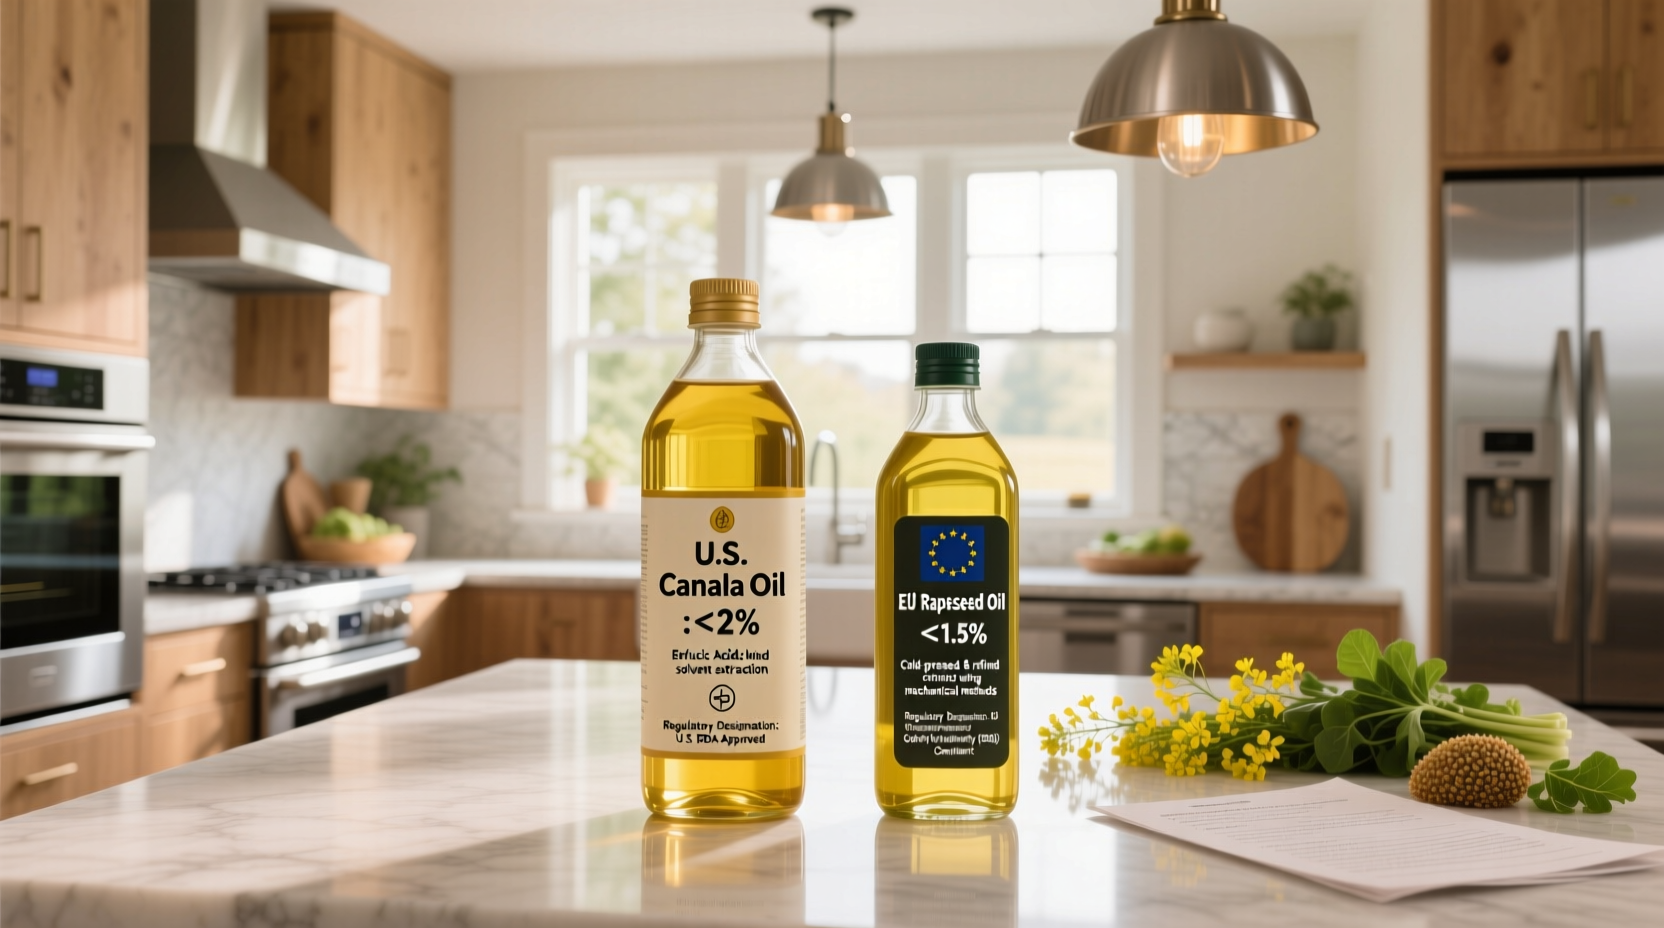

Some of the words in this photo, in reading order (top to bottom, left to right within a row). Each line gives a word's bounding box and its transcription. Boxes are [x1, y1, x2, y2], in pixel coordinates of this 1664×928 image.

[695, 541, 748, 566] U.S.
[749, 571, 785, 597] Oil
[898, 591, 917, 611] EU
[987, 592, 1006, 611] Oil
[920, 622, 988, 645] <1.5%
